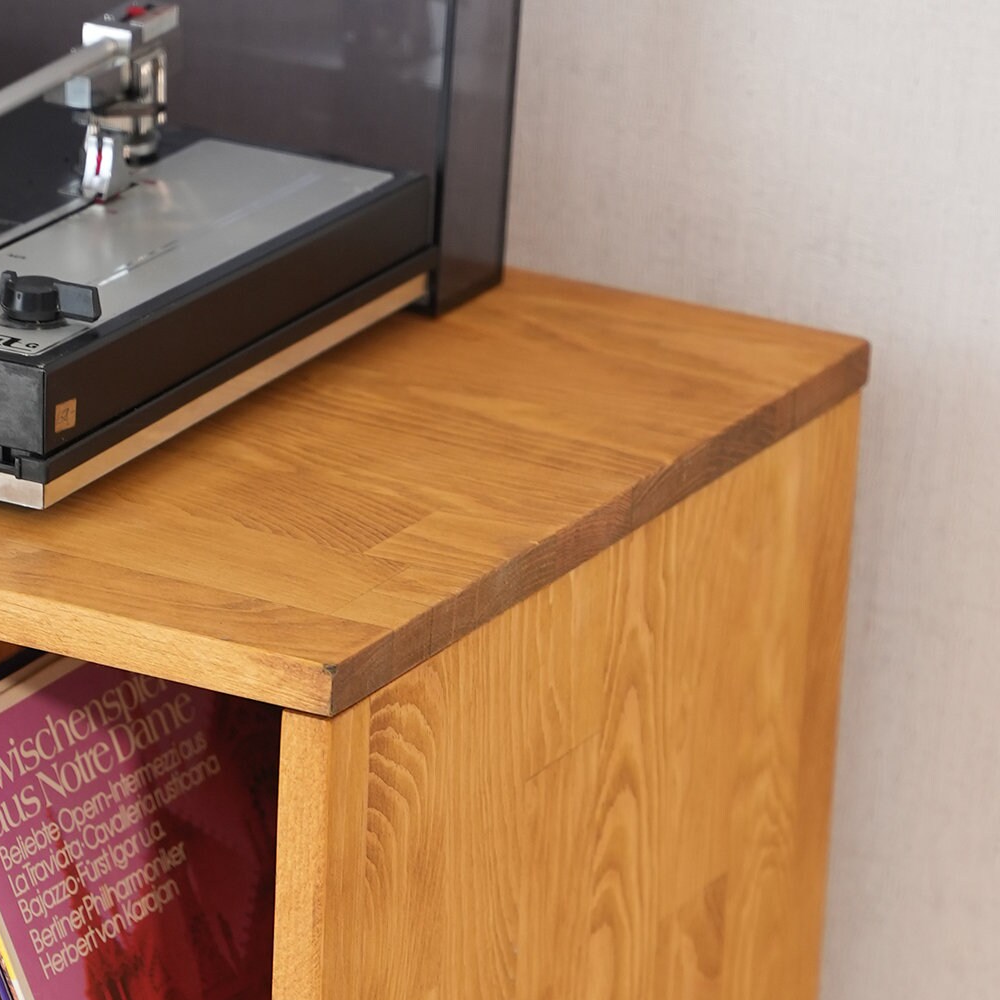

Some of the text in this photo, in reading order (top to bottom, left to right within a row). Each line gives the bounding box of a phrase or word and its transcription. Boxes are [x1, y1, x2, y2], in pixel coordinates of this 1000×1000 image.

[35, 741, 114, 808] Notre
[108, 692, 196, 764] Dame
[178, 731, 208, 769] aus
[8, 873, 27, 898] La
[154, 755, 221, 808] rusticana
[107, 834, 139, 870] Igor
[29, 840, 186, 954] Berliner Philharmoniker
[38, 878, 180, 980] Herbert von Karajan
